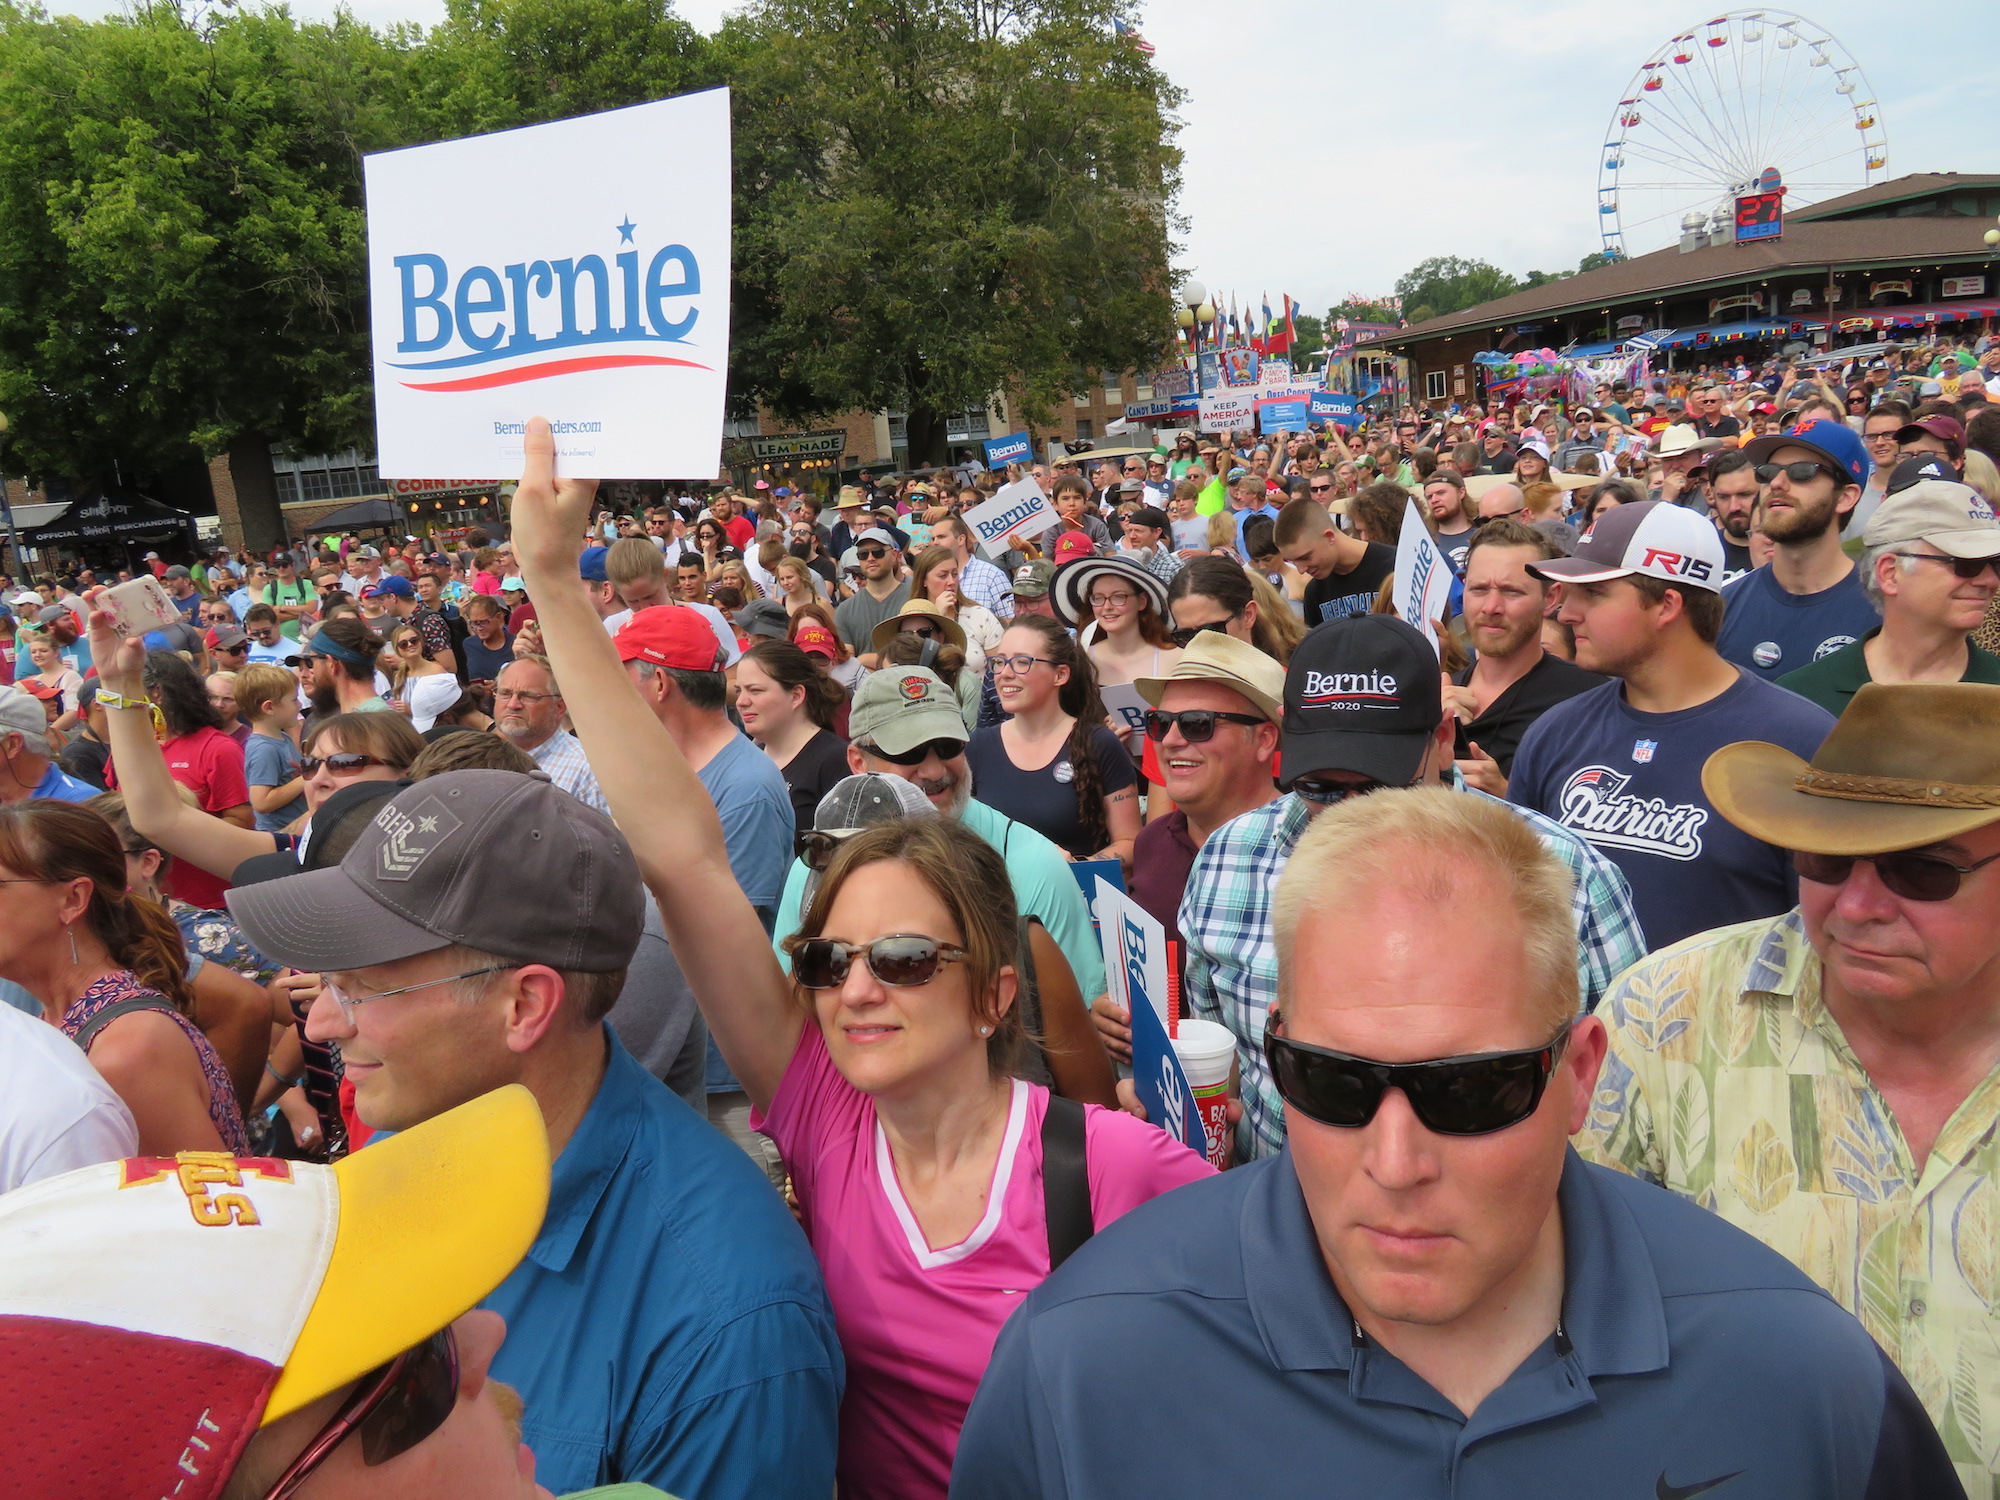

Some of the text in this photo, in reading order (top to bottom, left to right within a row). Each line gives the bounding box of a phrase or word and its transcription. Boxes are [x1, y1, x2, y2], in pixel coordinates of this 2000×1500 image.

[1737, 195, 1780, 226] 27
[1737, 221, 1780, 239] BEER
[393, 213, 701, 353] Bernie
[1129, 403, 1168, 416] CANDY BARS
[1203, 409, 1250, 420] AMERICA
[1214, 401, 1237, 410] KEEP
[1312, 401, 1352, 414] Bernie
[1210, 419, 1244, 429] GREAT!
[758, 437, 840, 456] LEMONADE
[989, 441, 1027, 459] Bernie
[396, 480, 446, 493] CORN
[976, 496, 1044, 539] Bernie
[36, 530, 79, 541] OFFICIAL
[114, 518, 177, 531] MERCHANDISE
[1642, 548, 1713, 581] R15
[644, 647, 667, 660] Reebok
[1303, 668, 1398, 694] Bernie
[1331, 702, 1360, 711] 2020
[1635, 749, 1652, 760] NFL
[1566, 786, 1703, 845] Patriots
[161, 1407, 220, 1500] -FIT
